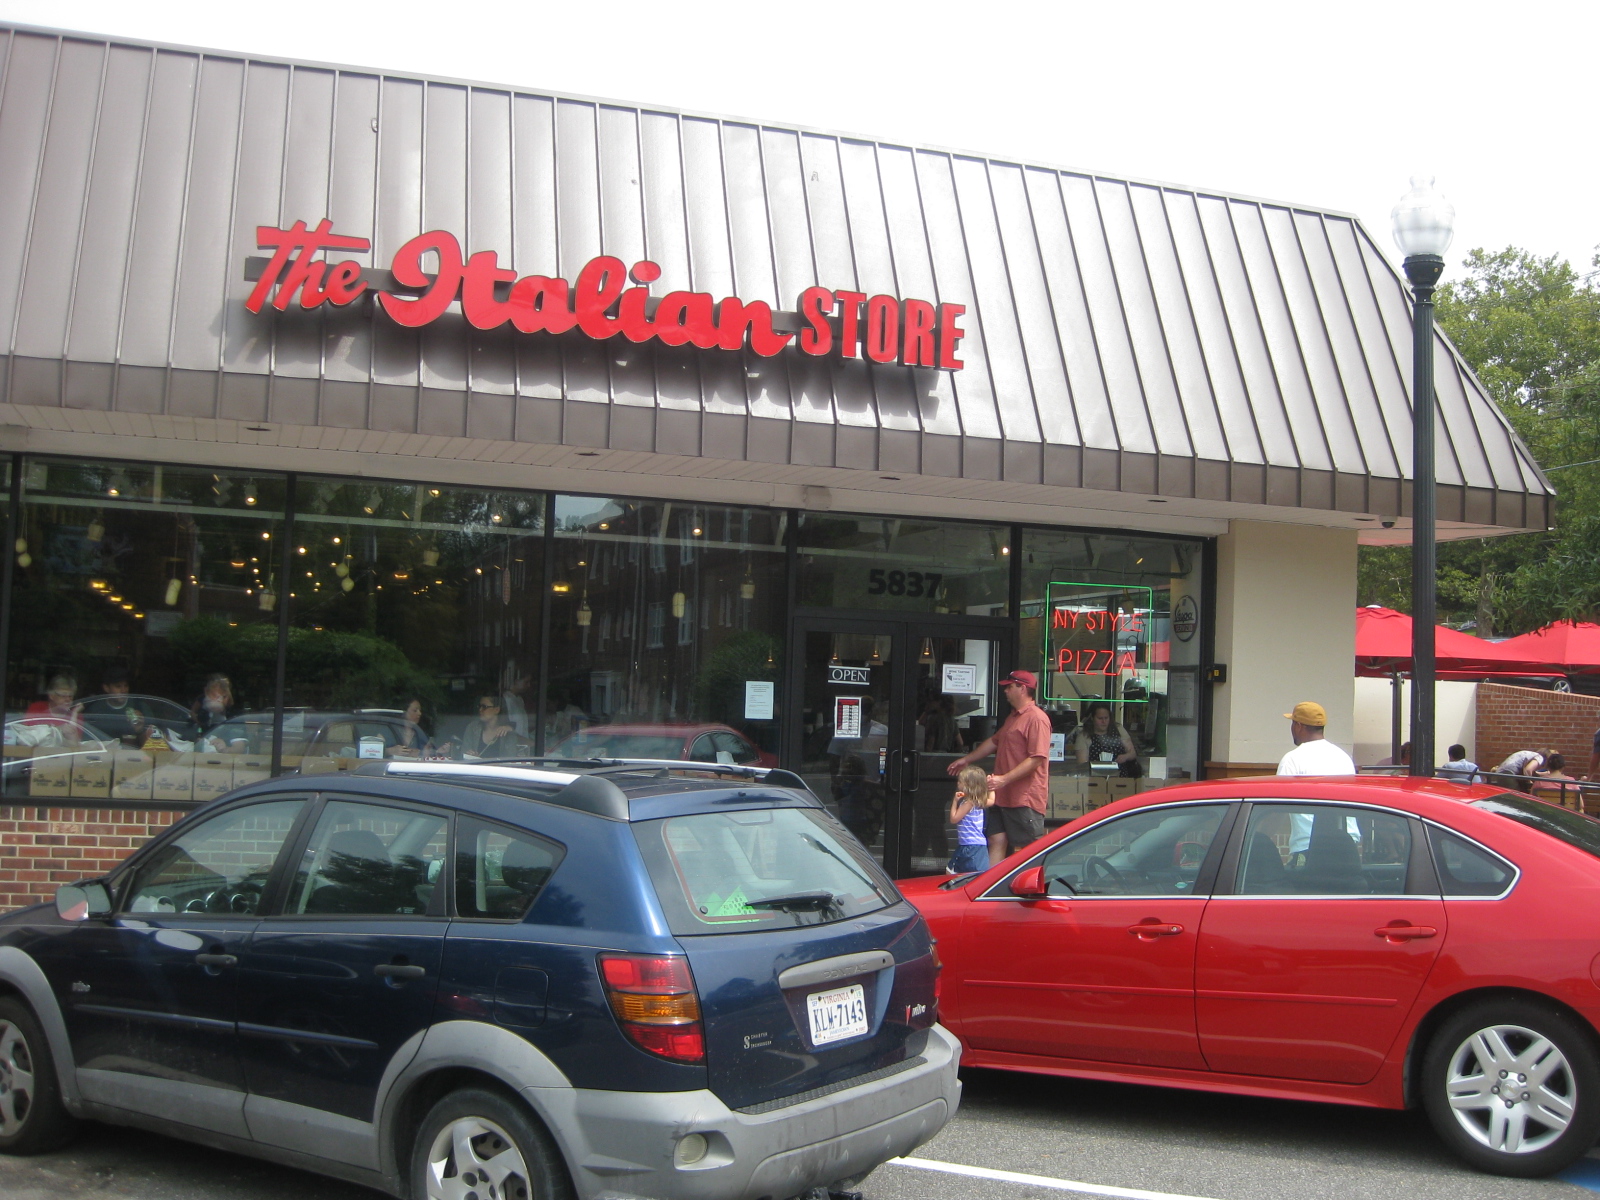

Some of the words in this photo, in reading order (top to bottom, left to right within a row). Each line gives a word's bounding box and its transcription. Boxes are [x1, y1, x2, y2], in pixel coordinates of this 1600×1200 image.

[245, 218, 371, 315] The
[377, 229, 797, 357] Italian
[798, 286, 966, 370] STORE
[868, 568, 943, 599] 5837
[1053, 609, 1080, 629] NY
[1086, 610, 1144, 632] STYLE
[832, 668, 867, 682] OPEN
[1058, 648, 1137, 677] PIZZA
[823, 962, 868, 979] PONTIAC
[822, 991, 850, 1005] VIRGINIA
[812, 999, 864, 1033] KLM-7143
